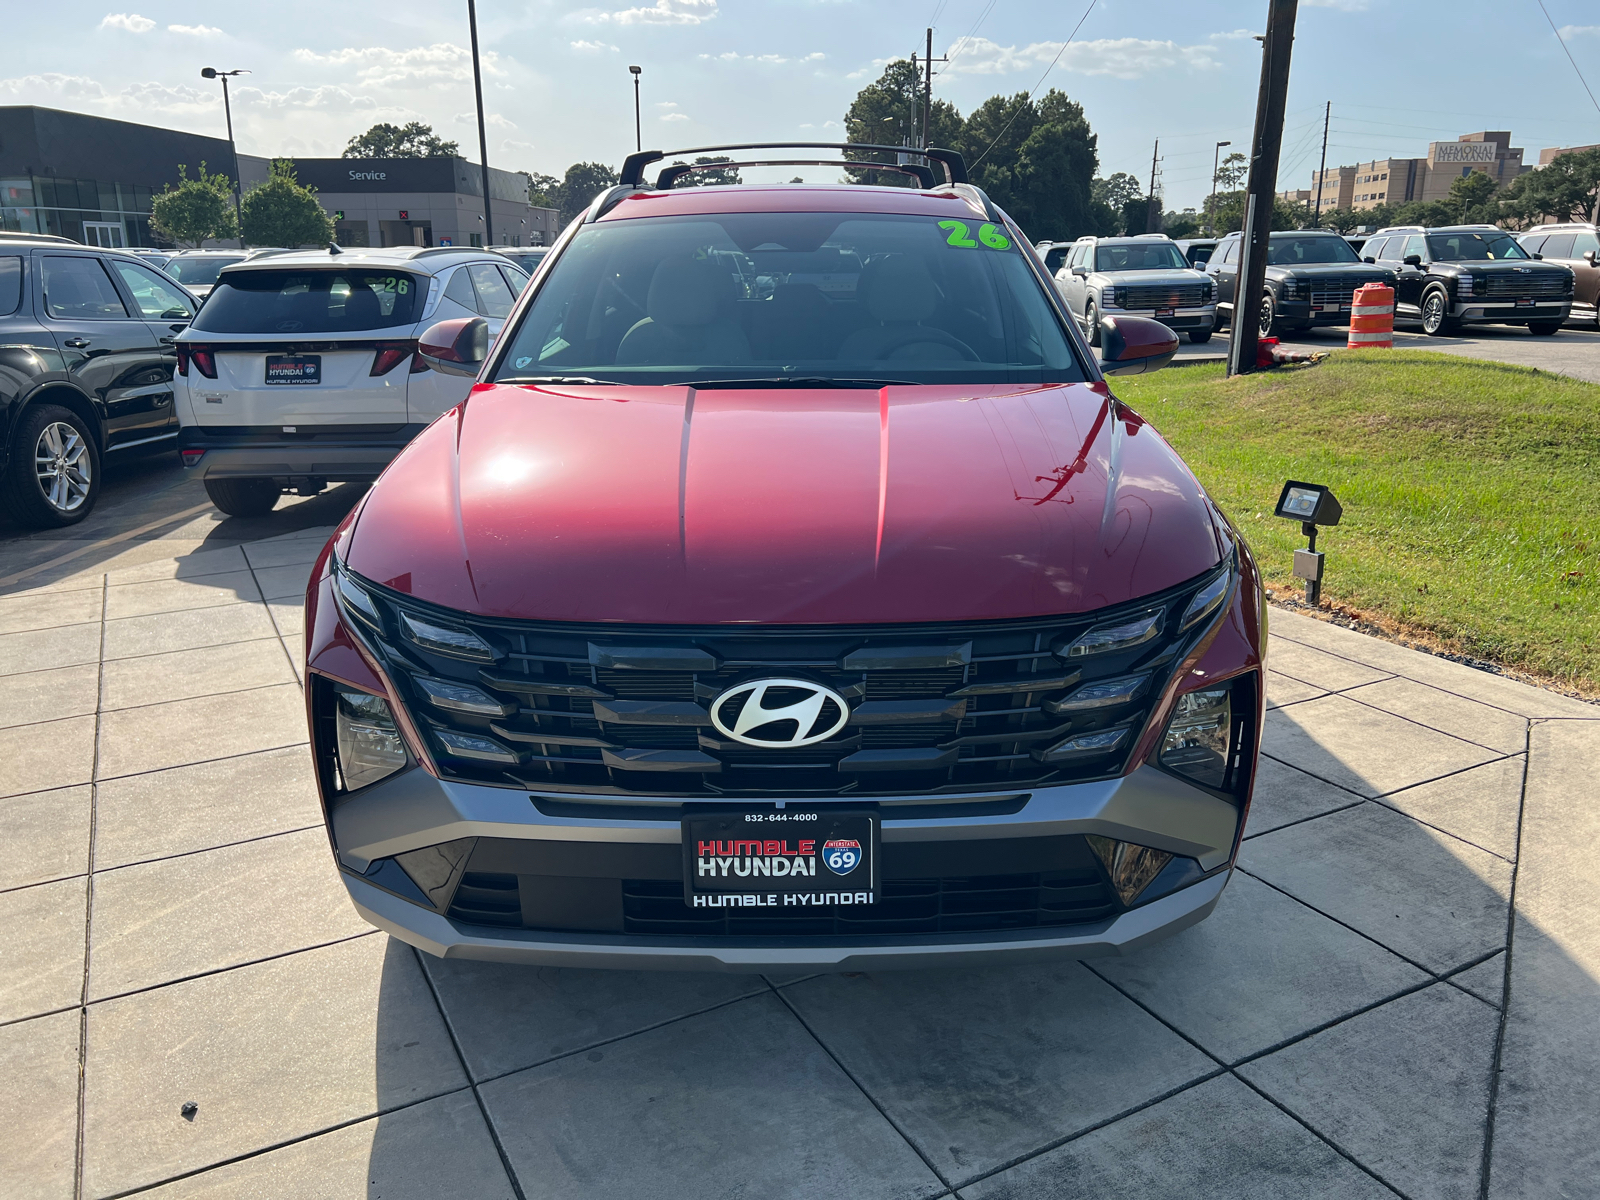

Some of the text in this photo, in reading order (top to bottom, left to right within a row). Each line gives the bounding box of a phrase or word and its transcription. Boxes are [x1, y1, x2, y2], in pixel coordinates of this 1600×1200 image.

[1437, 153, 1493, 161] HERMANN
[1439, 145, 1494, 154] MEMORIAL
[348, 170, 387, 180] Service
[937, 220, 1012, 251] 26
[384, 277, 409, 295] 26
[744, 813, 818, 822] 832-644-4000
[697, 840, 816, 857] HUMBLE
[698, 857, 816, 877] HYUNDAI
[828, 852, 856, 869] 69
[693, 892, 874, 907] HUMBLE HYUNDAI
